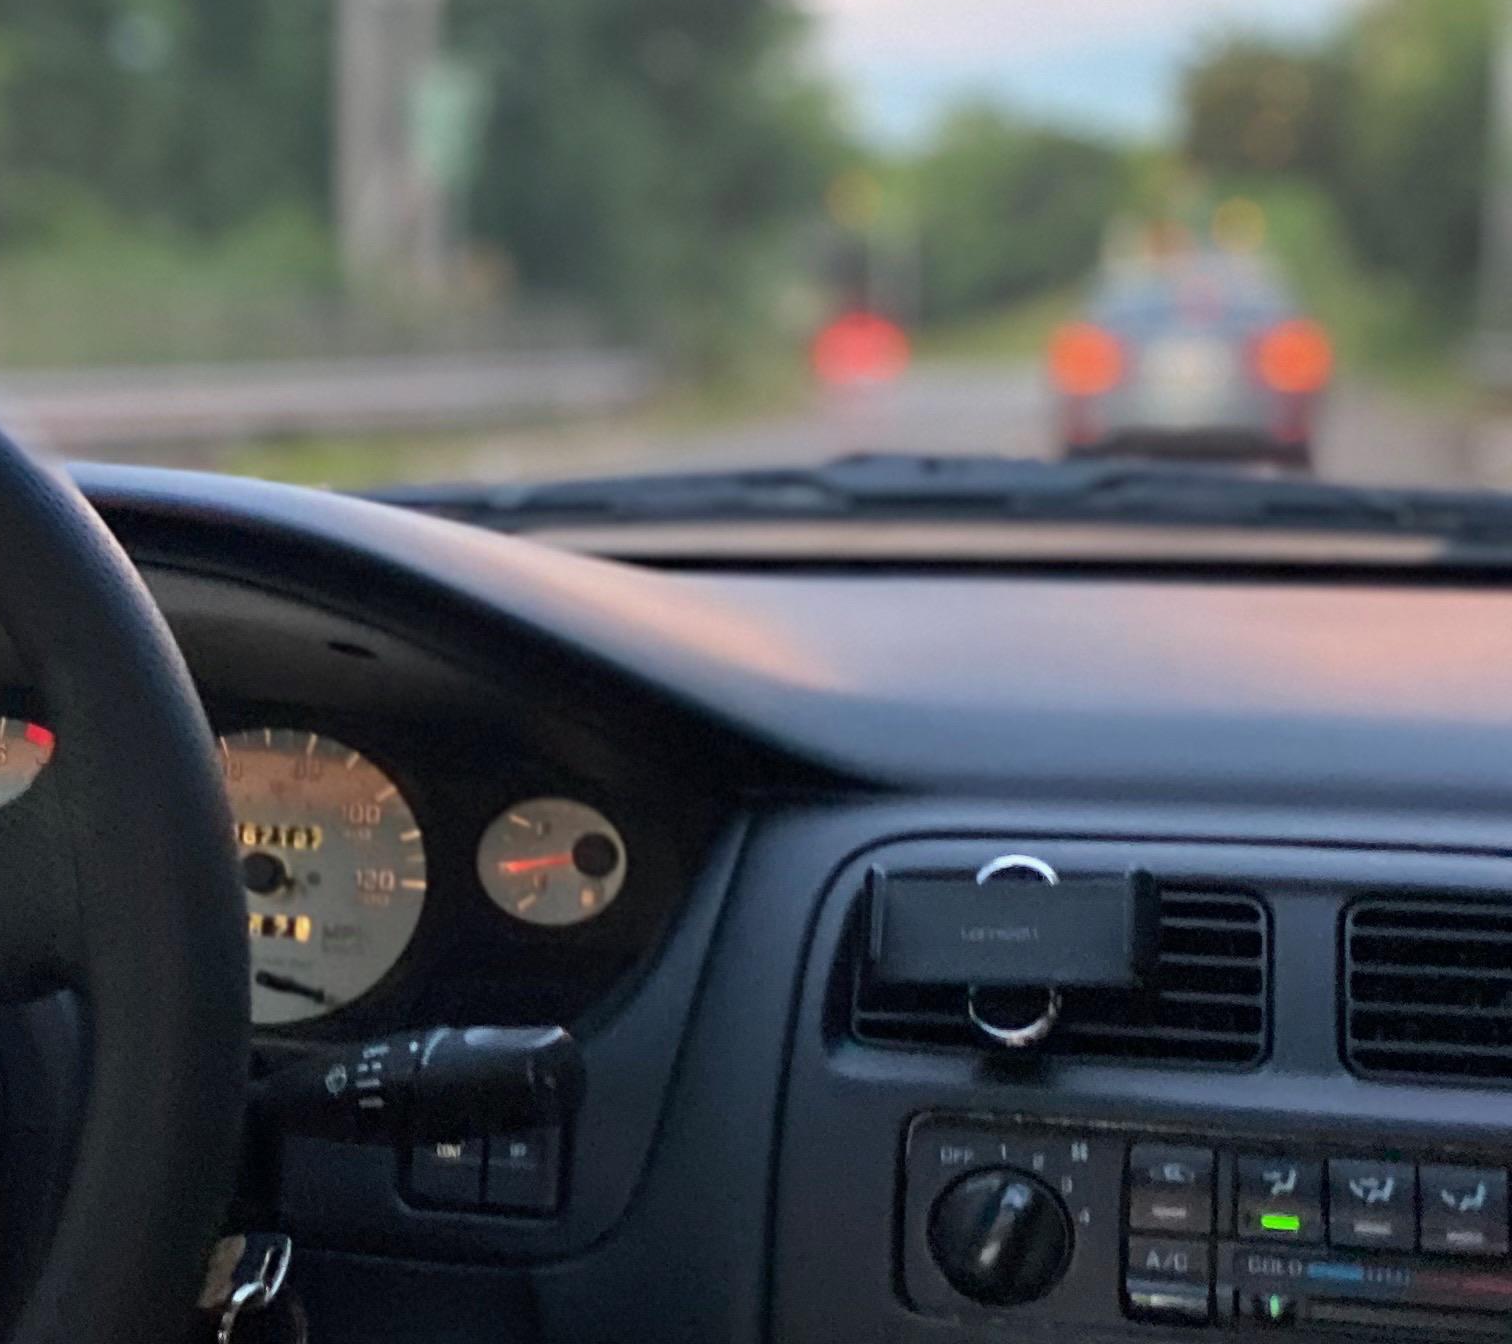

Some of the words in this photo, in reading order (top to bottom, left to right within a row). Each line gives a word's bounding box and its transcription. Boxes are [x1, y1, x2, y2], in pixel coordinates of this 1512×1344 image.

[343, 805, 381, 824] 100
[357, 869, 395, 892] 120
[1145, 1248, 1188, 1272] A/C
